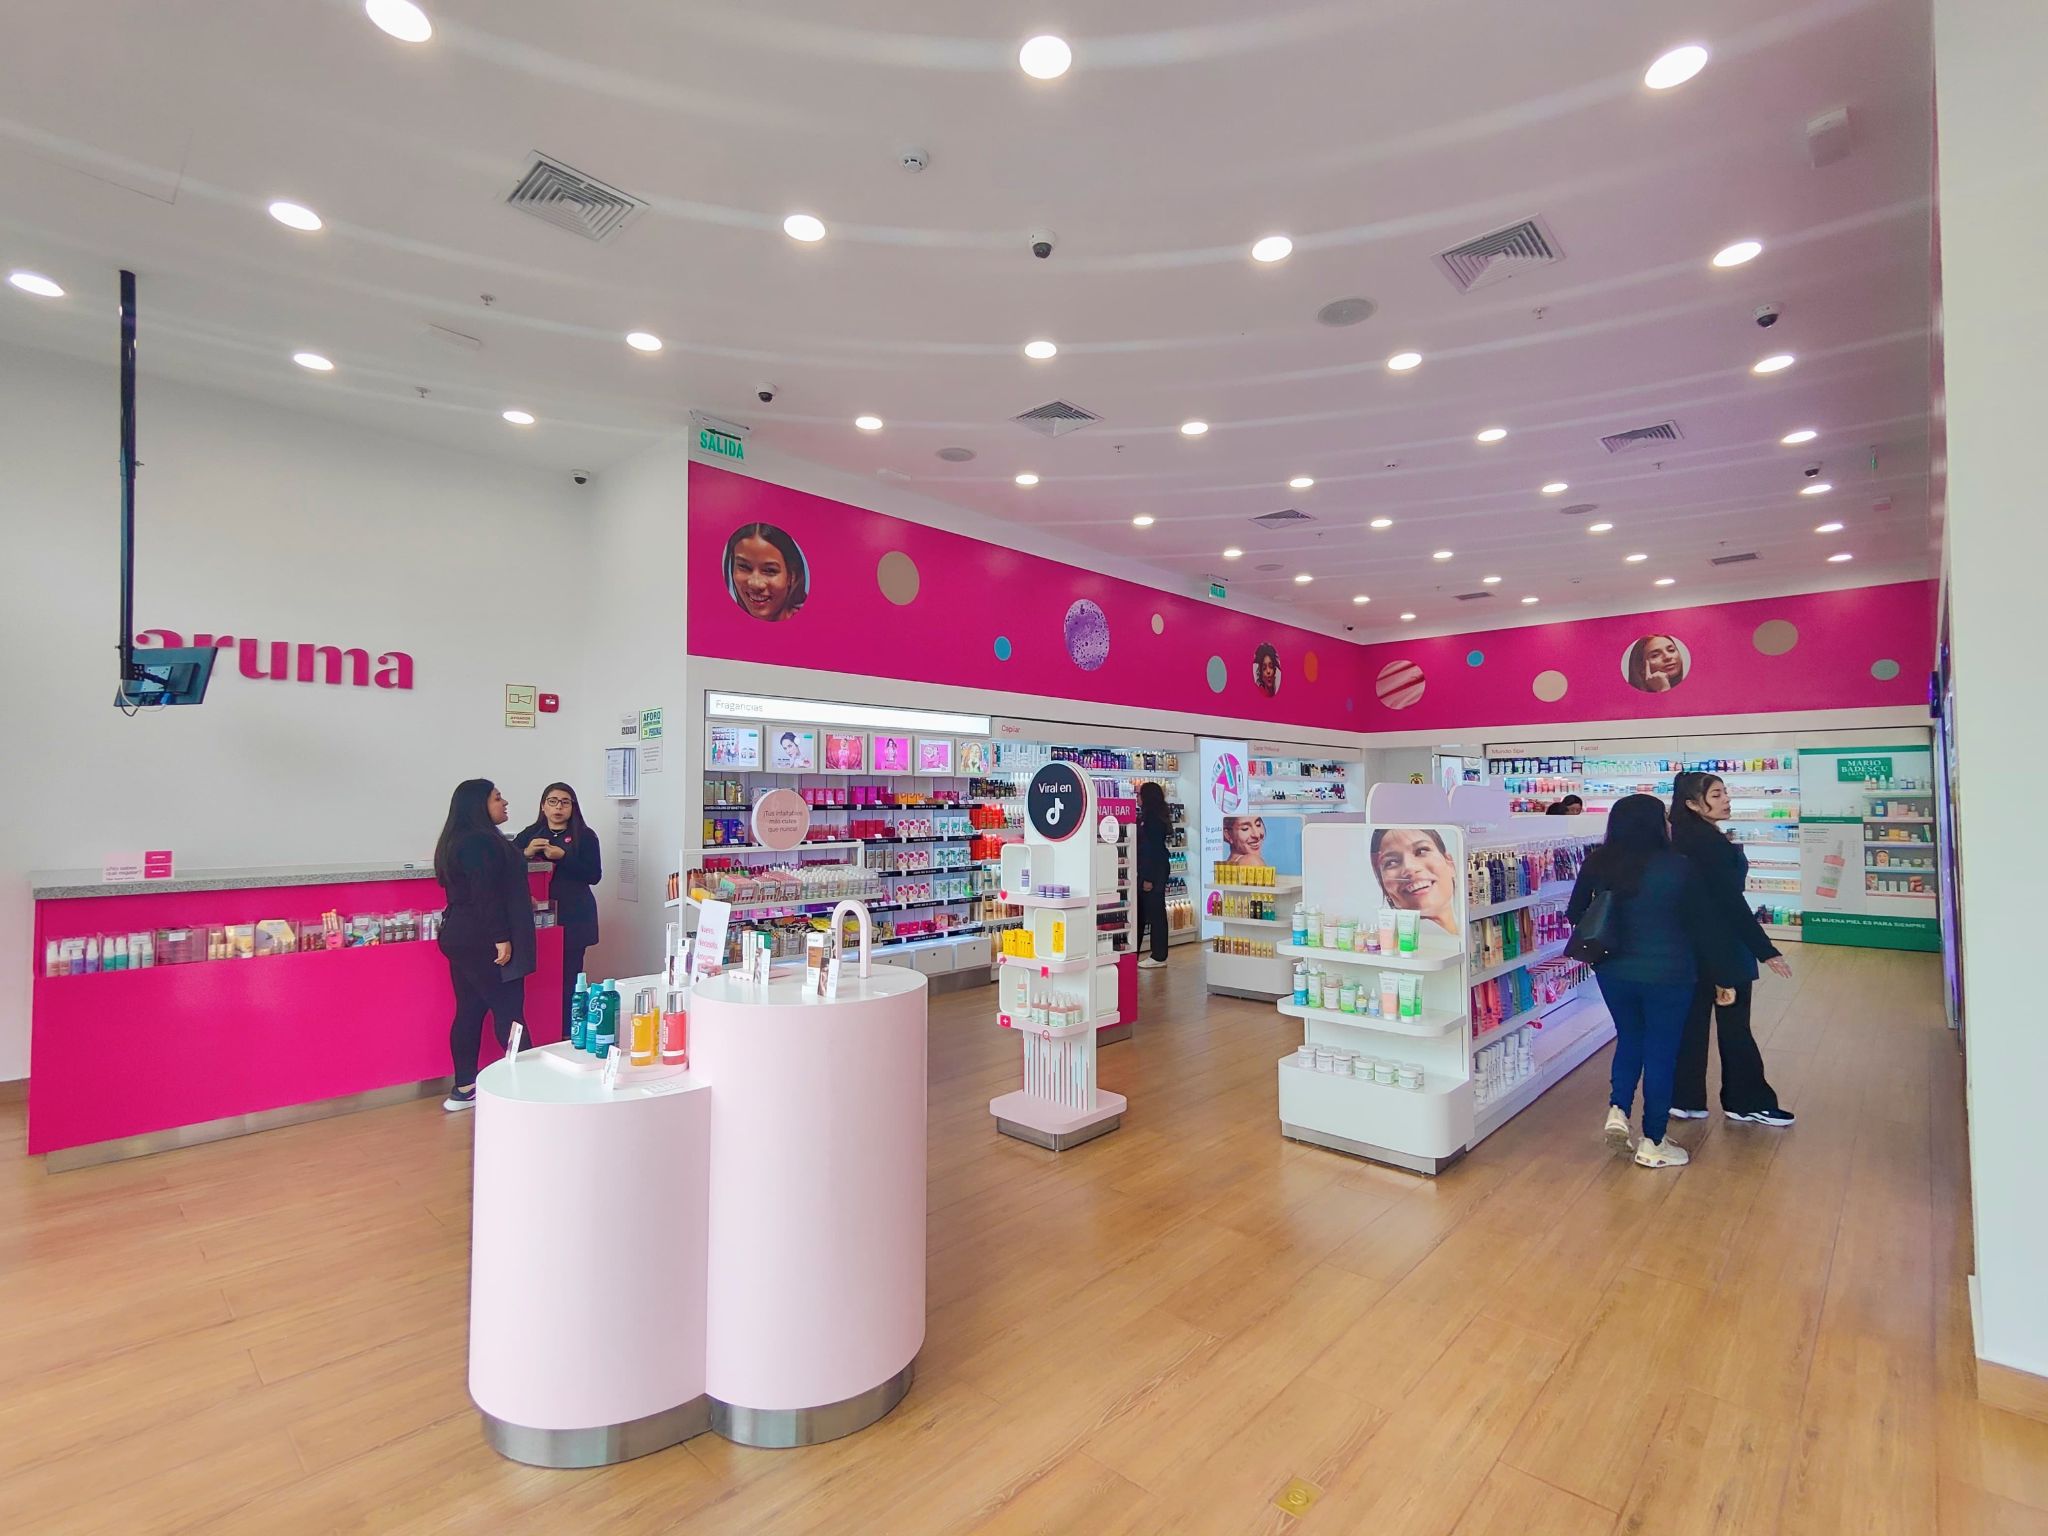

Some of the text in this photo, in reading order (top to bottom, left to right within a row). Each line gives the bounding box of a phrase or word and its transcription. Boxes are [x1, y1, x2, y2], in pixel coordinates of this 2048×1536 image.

[701, 431, 744, 460] SALIDA
[716, 699, 763, 712] Fragancias
[643, 711, 661, 722] AFORO
[1039, 782, 1072, 793] Viral en
[1115, 806, 1130, 816] BAR
